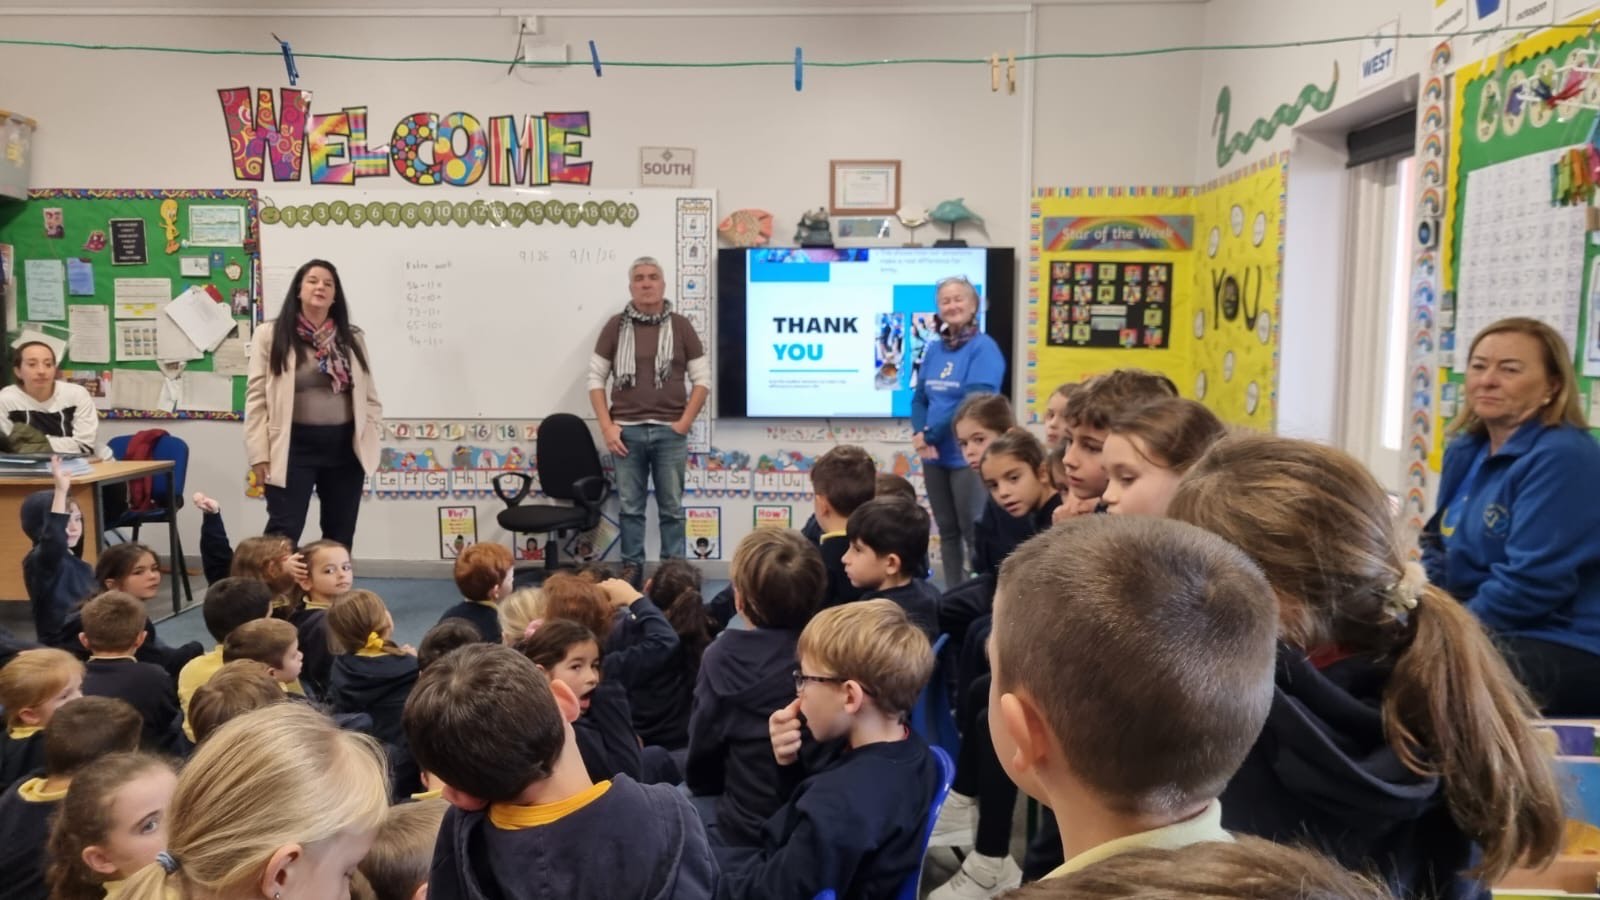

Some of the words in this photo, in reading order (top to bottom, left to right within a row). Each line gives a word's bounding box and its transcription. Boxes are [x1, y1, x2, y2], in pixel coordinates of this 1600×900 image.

[1362, 48, 1393, 78] WEST
[217, 86, 593, 187] WELCOME
[644, 162, 691, 176] SOUTH
[437, 206, 450, 217] 10
[457, 207, 468, 218] 11
[473, 206, 486, 217] 12
[511, 208, 523, 219] 14
[530, 206, 543, 217] 15
[549, 205, 562, 216] 16
[566, 208, 579, 219] 17
[585, 206, 598, 218] 18
[604, 205, 616, 217] 19
[620, 207, 637, 219] 20
[1062, 229, 1090, 241] Star
[1094, 226, 1109, 243] of
[1112, 227, 1134, 240] the
[1137, 226, 1172, 240] Week
[1211, 264, 1263, 331] YOU
[773, 317, 858, 333] THANK
[773, 344, 824, 361] YOU
[417, 424, 435, 437] 12
[471, 425, 488, 438] 16
[500, 425, 516, 438] 18
[380, 472, 397, 485] Ee
[404, 472, 418, 485] Ff
[426, 472, 446, 490] Gg
[455, 471, 474, 484] Hh
[707, 471, 723, 483] Rr
[783, 473, 801, 486] Uu
[758, 509, 788, 518] How?
